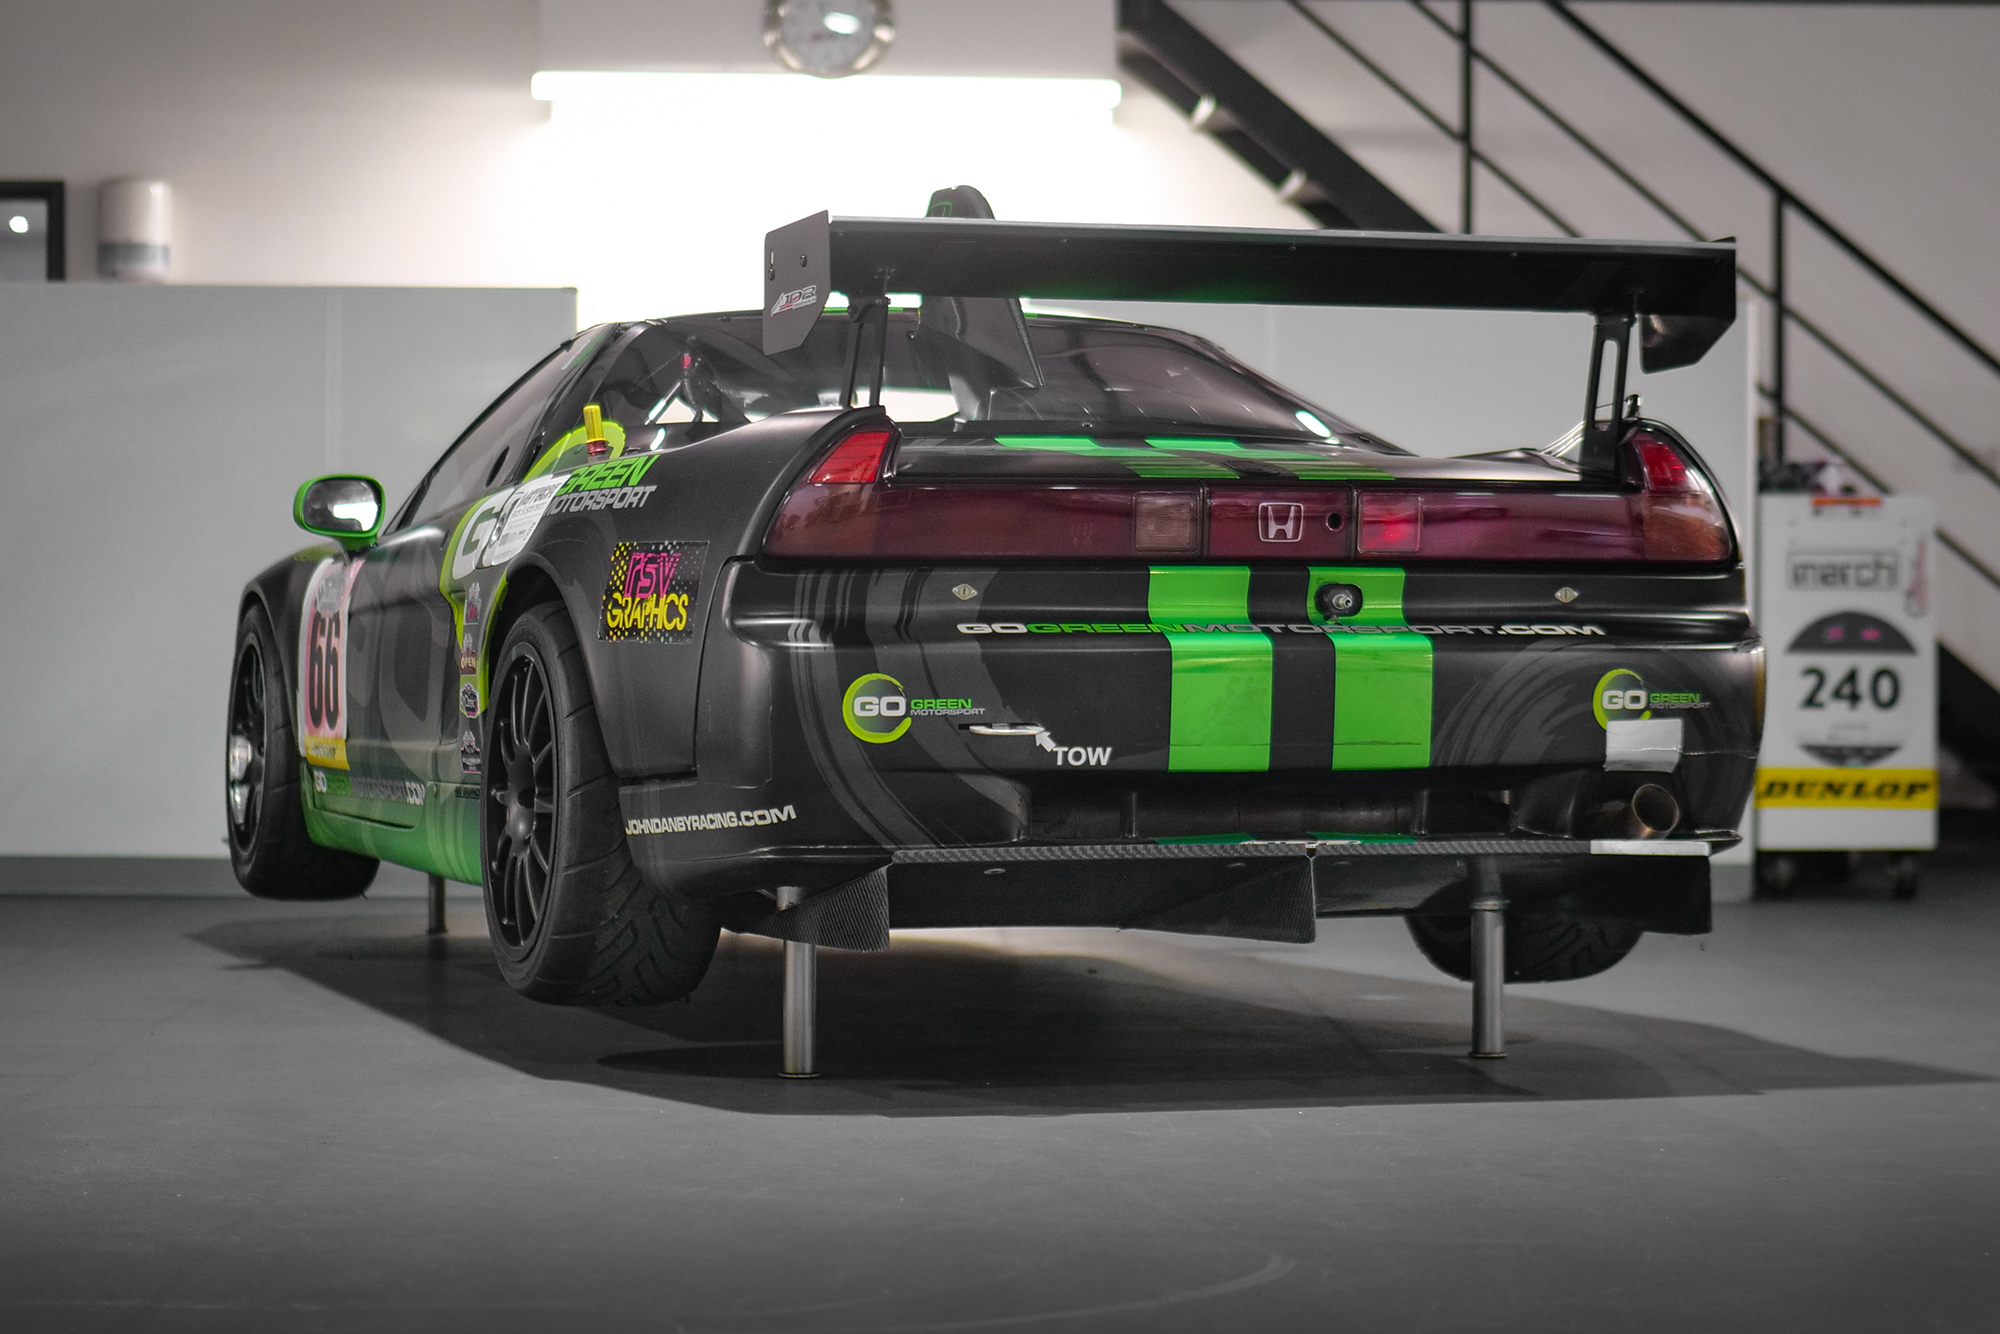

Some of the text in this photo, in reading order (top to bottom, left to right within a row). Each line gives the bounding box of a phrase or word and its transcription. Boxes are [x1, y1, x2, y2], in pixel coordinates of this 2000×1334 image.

[556, 454, 660, 496] GREEN
[607, 592, 689, 631] GRAPHICS
[309, 609, 340, 732] 66
[1649, 693, 1701, 703] GREEN
[1801, 666, 1900, 710] 240
[854, 696, 906, 717] GO
[910, 699, 972, 709] GREEN
[1602, 690, 1647, 710] GO
[910, 708, 986, 716] MOTORSPORT
[1052, 747, 1112, 766] TOW
[1761, 780, 1932, 801] DUNLOP
[625, 804, 797, 835] JOHNDANBYRACING.COM
